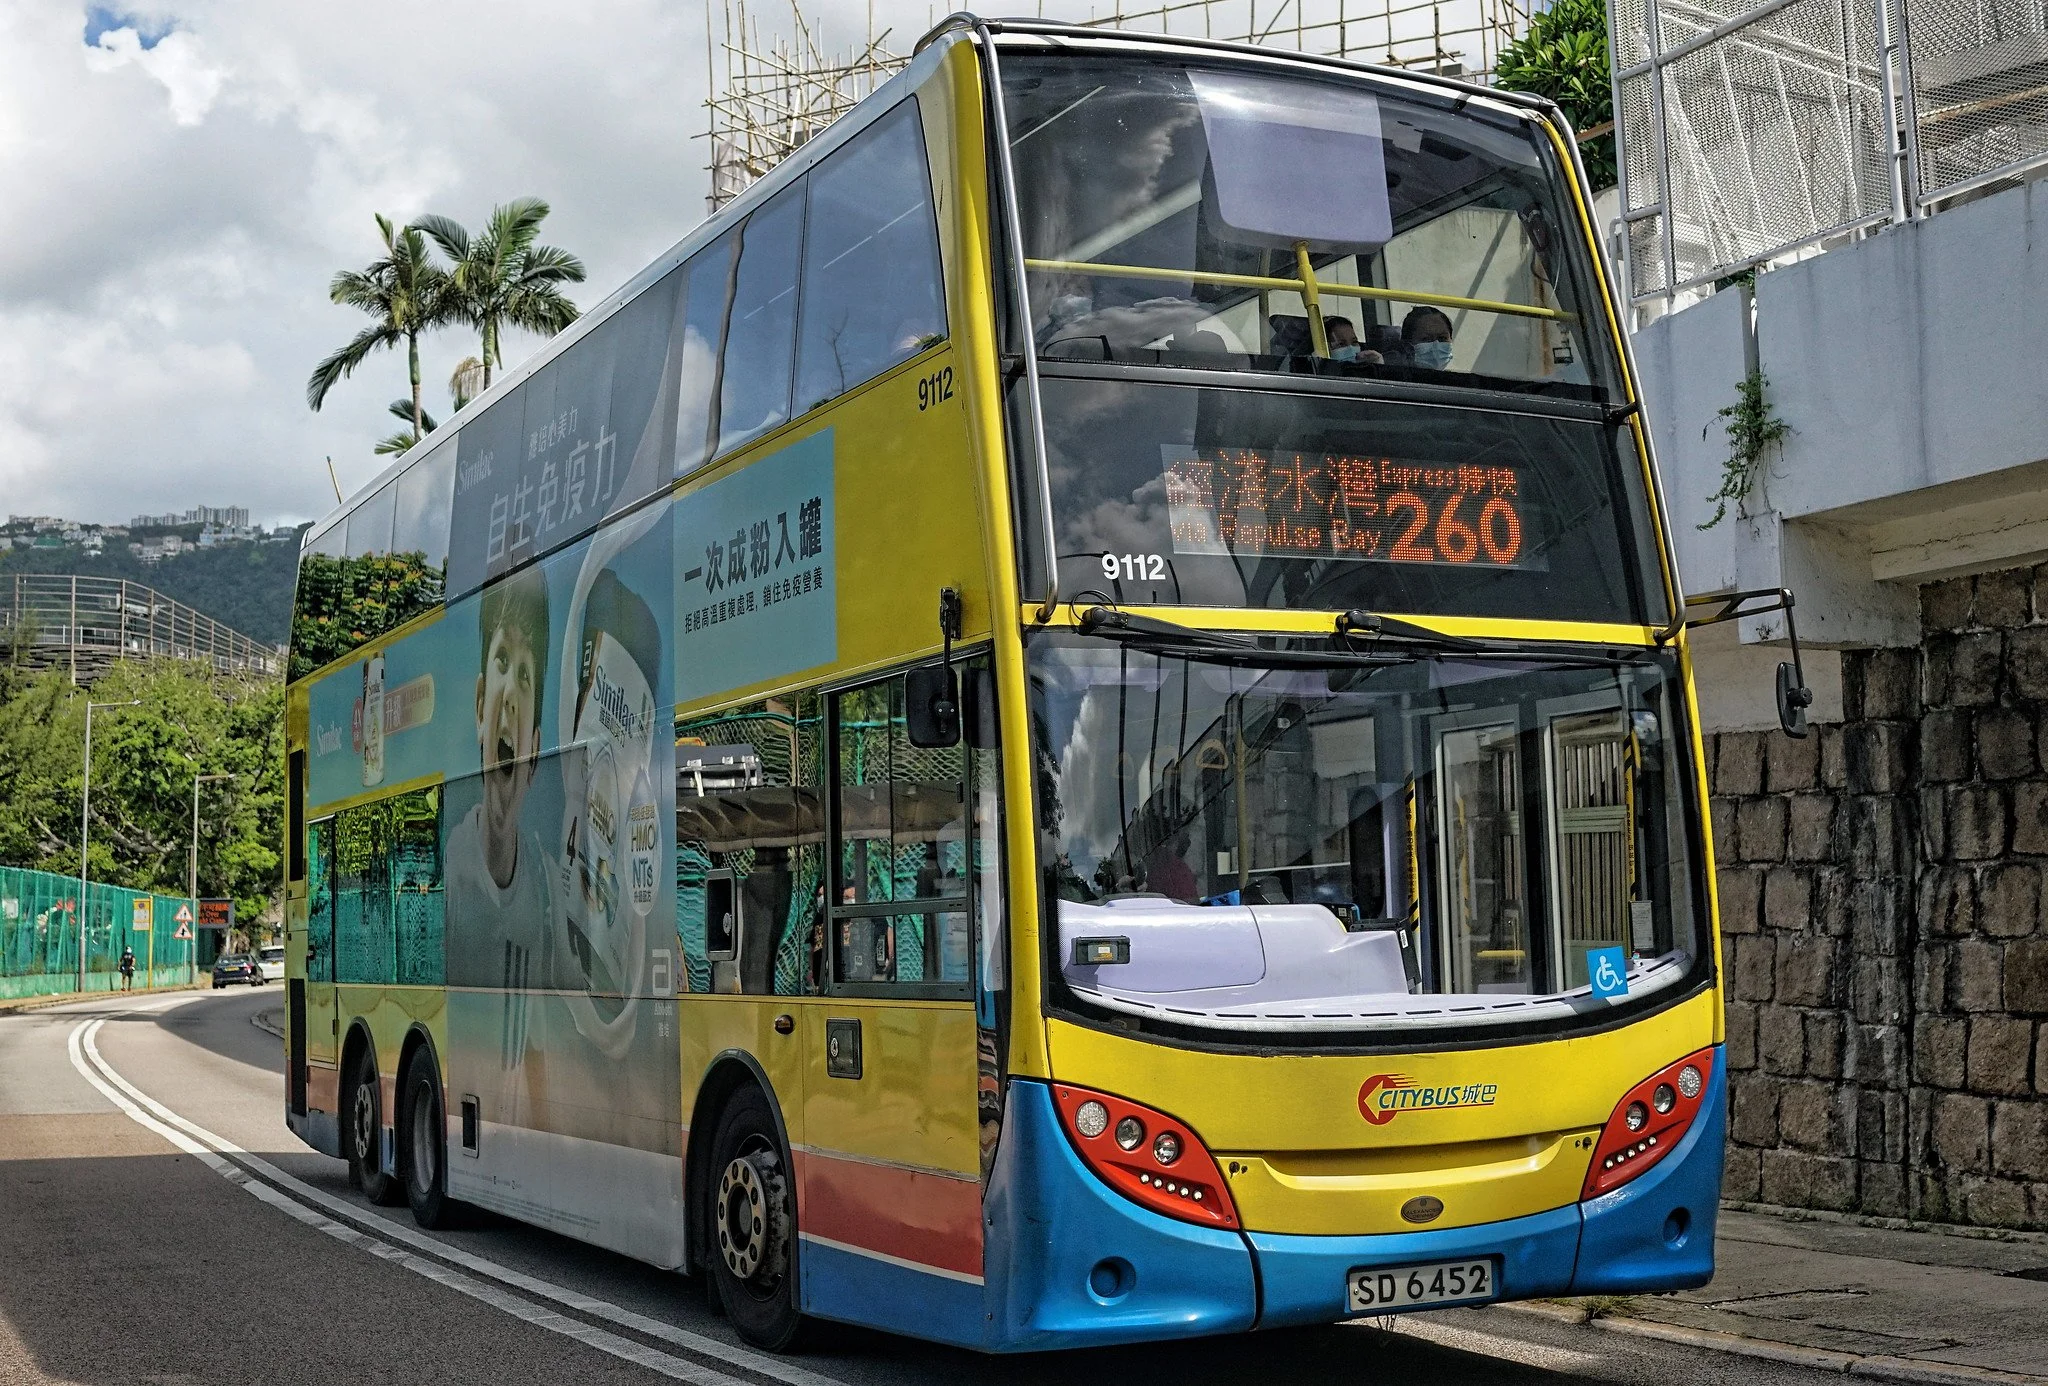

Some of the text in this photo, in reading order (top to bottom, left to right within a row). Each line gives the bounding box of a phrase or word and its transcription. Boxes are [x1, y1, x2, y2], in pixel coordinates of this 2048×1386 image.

[918, 366, 954, 411] 9112
[486, 424, 617, 565] 自生免疫力
[1168, 449, 1379, 516] 經淺水灣
[1381, 461, 1454, 490] Express
[684, 496, 822, 595] 一次成粉入罐
[1219, 514, 1321, 551] Repulse
[1332, 519, 1381, 556] Bay
[1386, 491, 1521, 564] 260
[1101, 553, 1166, 581] 9112
[593, 665, 636, 740] Similac
[631, 822, 655, 852] HMO
[1379, 1083, 1498, 1109] CITYBUS 城巴
[1357, 1264, 1487, 1305] SD 6452
